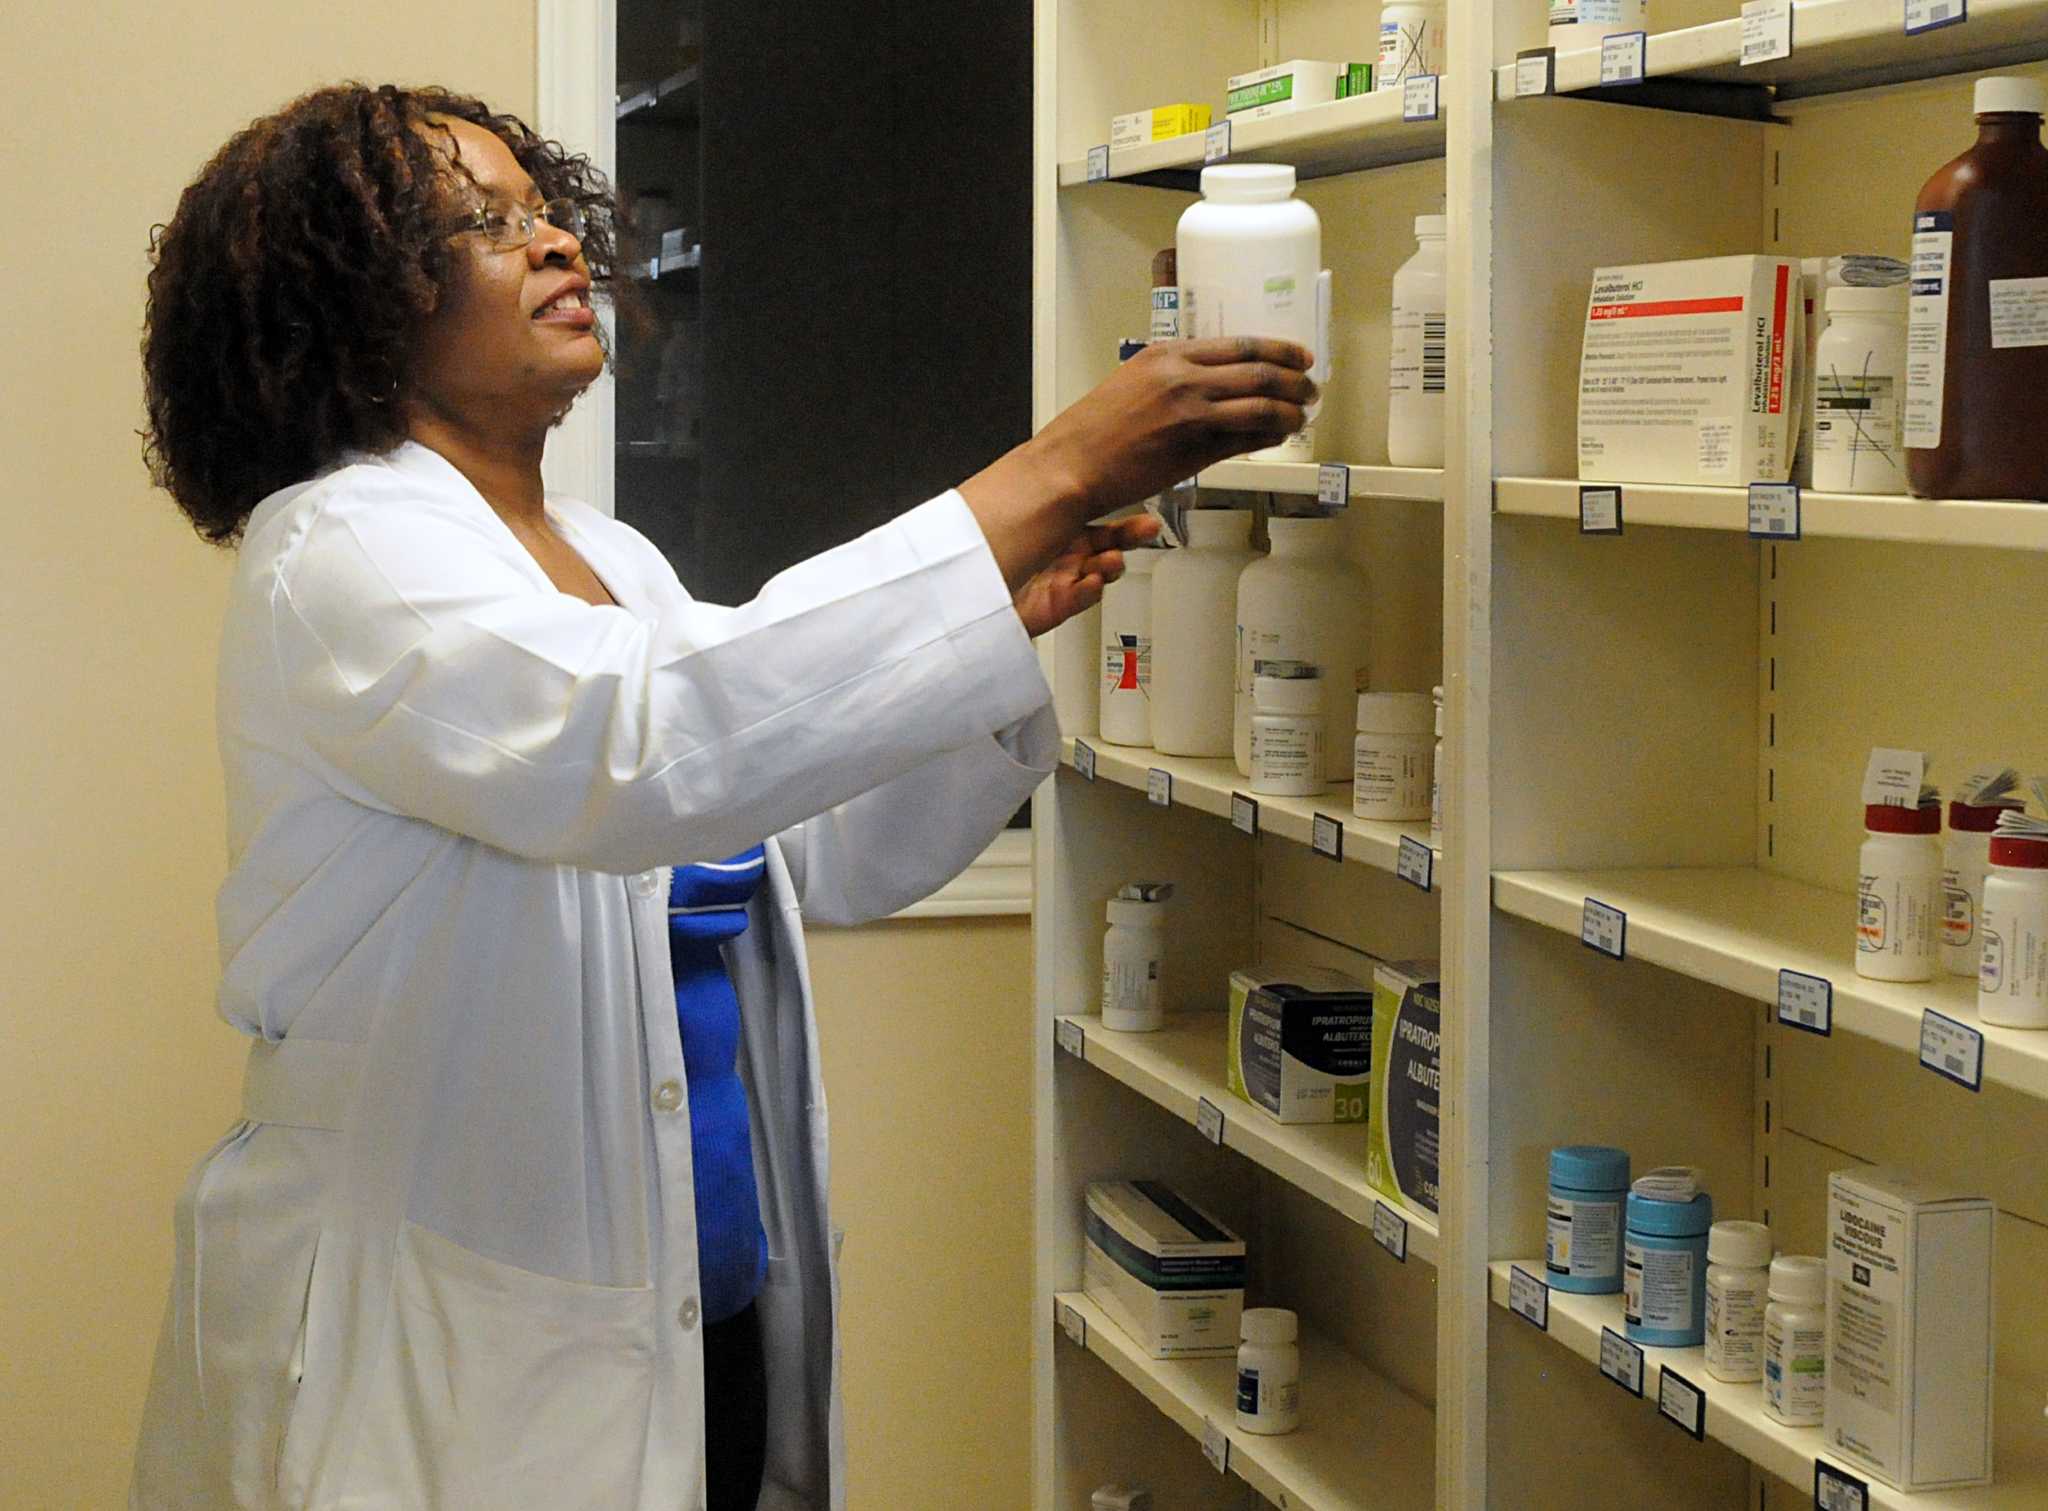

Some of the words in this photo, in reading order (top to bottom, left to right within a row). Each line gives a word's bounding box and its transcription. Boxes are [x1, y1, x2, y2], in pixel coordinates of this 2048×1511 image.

[1756, 317, 1766, 338] HCl
[1752, 341, 1764, 413] Levalbuterol
[1322, 1032, 1372, 1042] ALBUTERO
[1335, 1097, 1362, 1119] 30
[1368, 1151, 1382, 1188] 60
[1840, 1209, 1887, 1238] LIDOCAINE
[1844, 1224, 1883, 1249] VISCOUS
